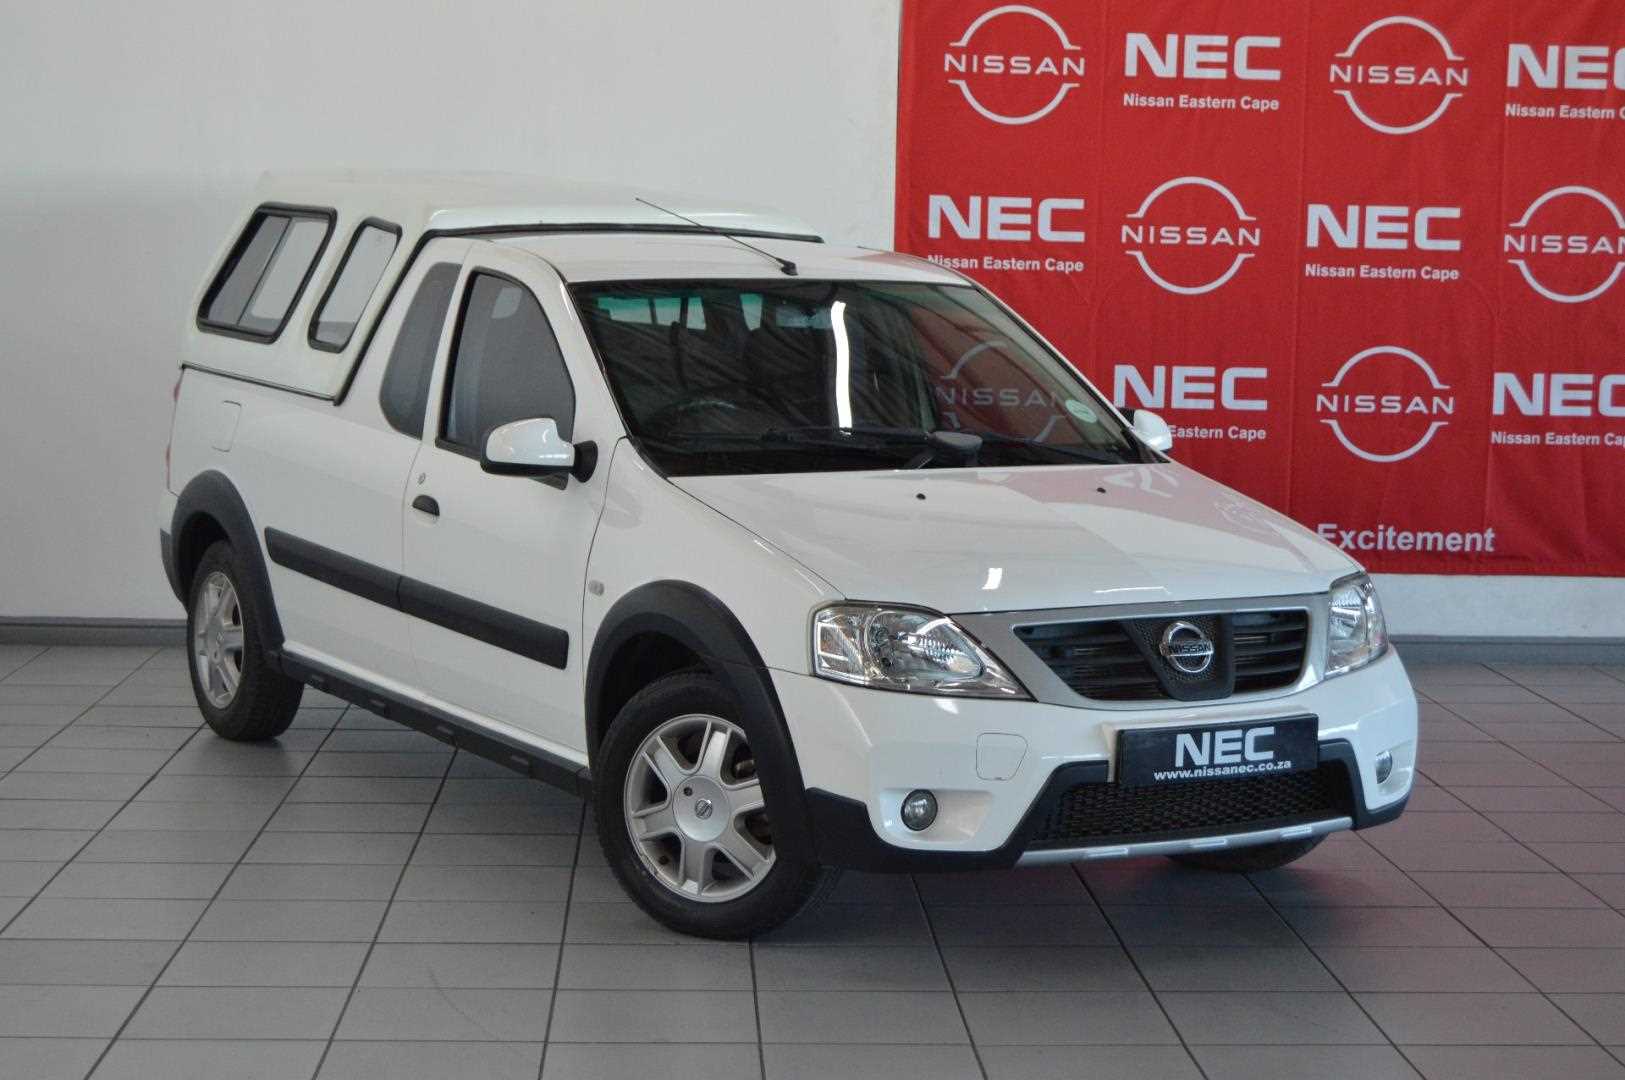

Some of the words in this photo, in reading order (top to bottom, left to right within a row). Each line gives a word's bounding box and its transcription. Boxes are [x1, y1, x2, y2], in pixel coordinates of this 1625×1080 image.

[944, 54, 1085, 76] NISSAN
[1124, 32, 1282, 81] NEC
[1506, 43, 1625, 90] NE
[1329, 64, 1469, 86] NISSAN
[1123, 93, 1174, 108] Nissan
[1179, 94, 1236, 109] Eastern
[1240, 96, 1280, 112] Cape
[1505, 103, 1554, 118] Nissan
[1559, 105, 1615, 119] Eastern
[927, 194, 1086, 242] NEC
[1306, 203, 1461, 251] NEC
[1121, 224, 1261, 247] NISSAN
[983, 256, 1040, 271] Eastern
[1044, 257, 1084, 274] Cape
[1305, 263, 1355, 277] Nissan
[1360, 265, 1416, 280] Eastern
[1420, 266, 1460, 282] Cape
[1114, 364, 1268, 411] NEC
[1492, 372, 1625, 417] NEC
[1316, 393, 1455, 415] NISSAN
[1168, 425, 1223, 440] Eastern
[1227, 425, 1267, 441] Cape
[1491, 431, 1540, 445] Nissan
[1545, 432, 1600, 446] Eastern
[1317, 523, 1496, 552] Excitement
[1175, 726, 1275, 767] NEC
[1154, 760, 1291, 780] www.nissanec.co.za
